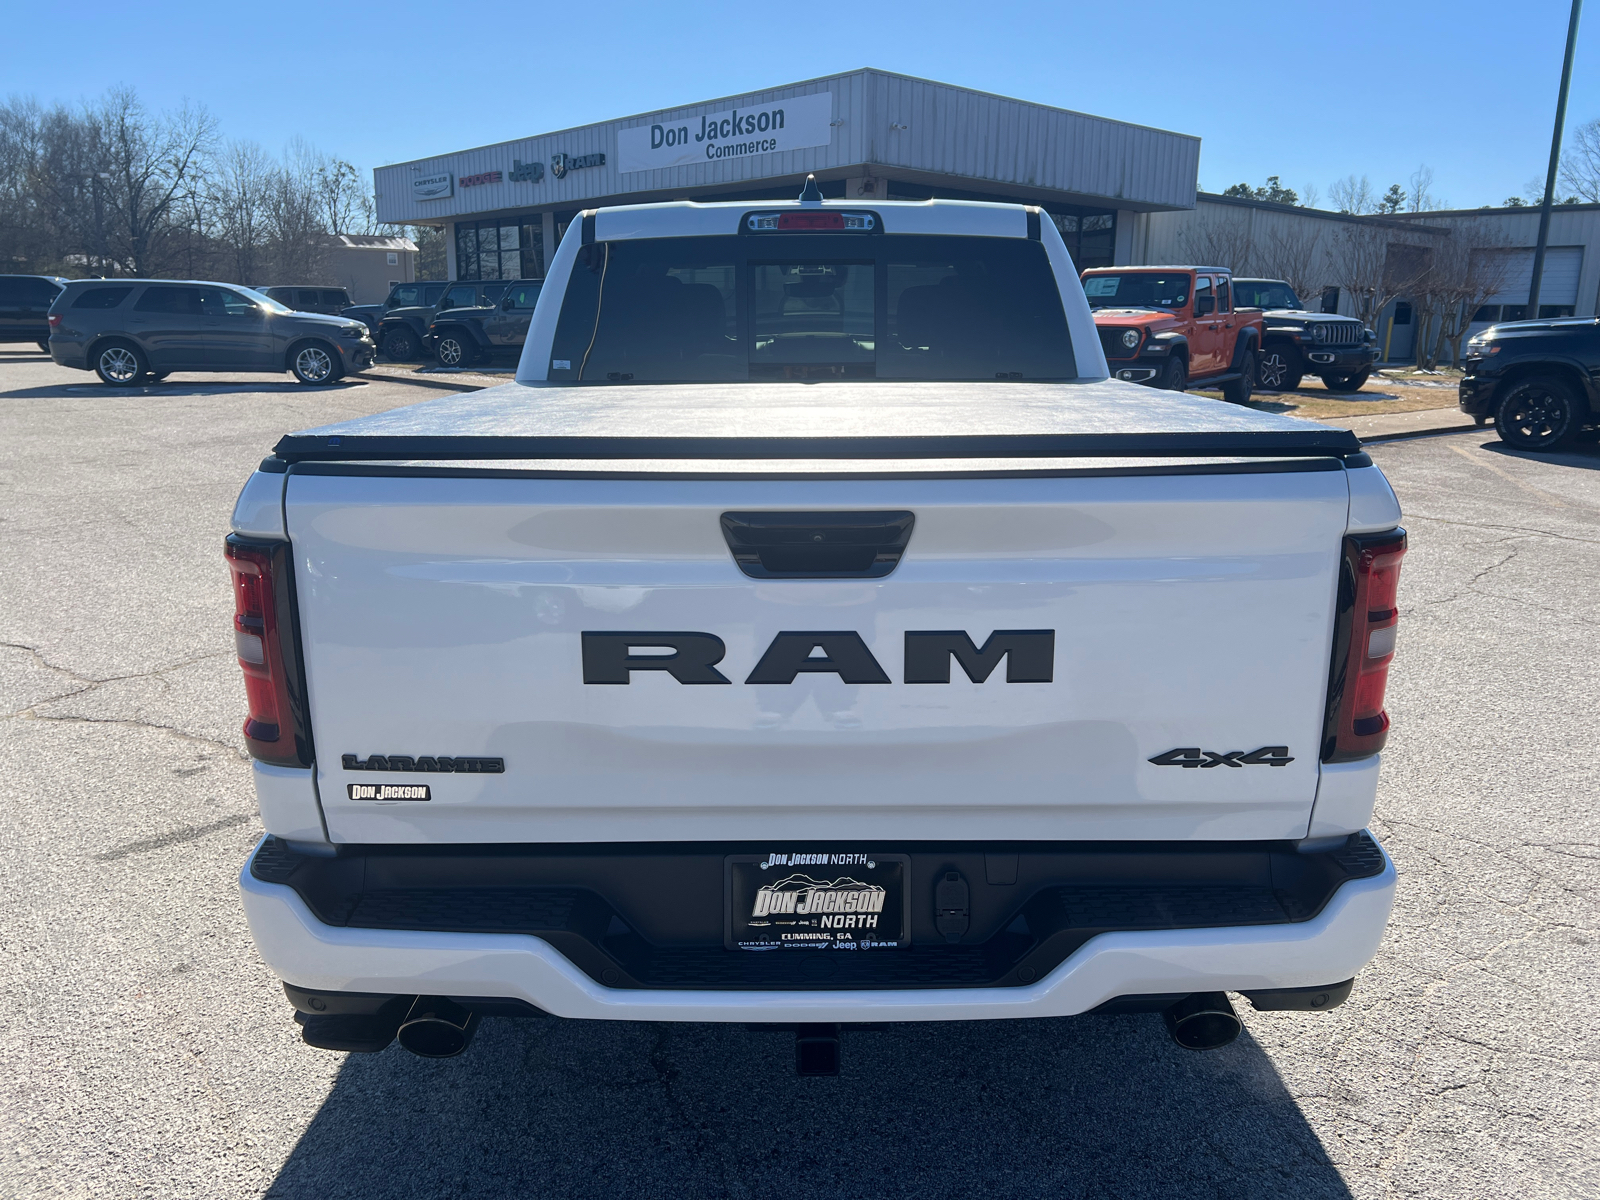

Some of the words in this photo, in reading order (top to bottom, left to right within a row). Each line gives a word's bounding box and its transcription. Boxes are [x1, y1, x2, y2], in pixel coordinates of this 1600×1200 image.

[651, 124, 688, 149] Don
[695, 108, 785, 143] Jackson
[706, 138, 777, 160] Commerce
[566, 153, 605, 171] RAM
[459, 171, 501, 188] DODGE
[509, 160, 544, 184] Jeep
[414, 176, 448, 187] CHRYSLER
[581, 629, 1055, 685] RAM
[341, 754, 505, 773] LARAMIE
[1147, 746, 1295, 768] 4x4
[830, 854, 867, 865] NORTH
[820, 915, 878, 929] NORTH
[781, 933, 834, 941] CUMMING,
[832, 940, 857, 950] Jeep
